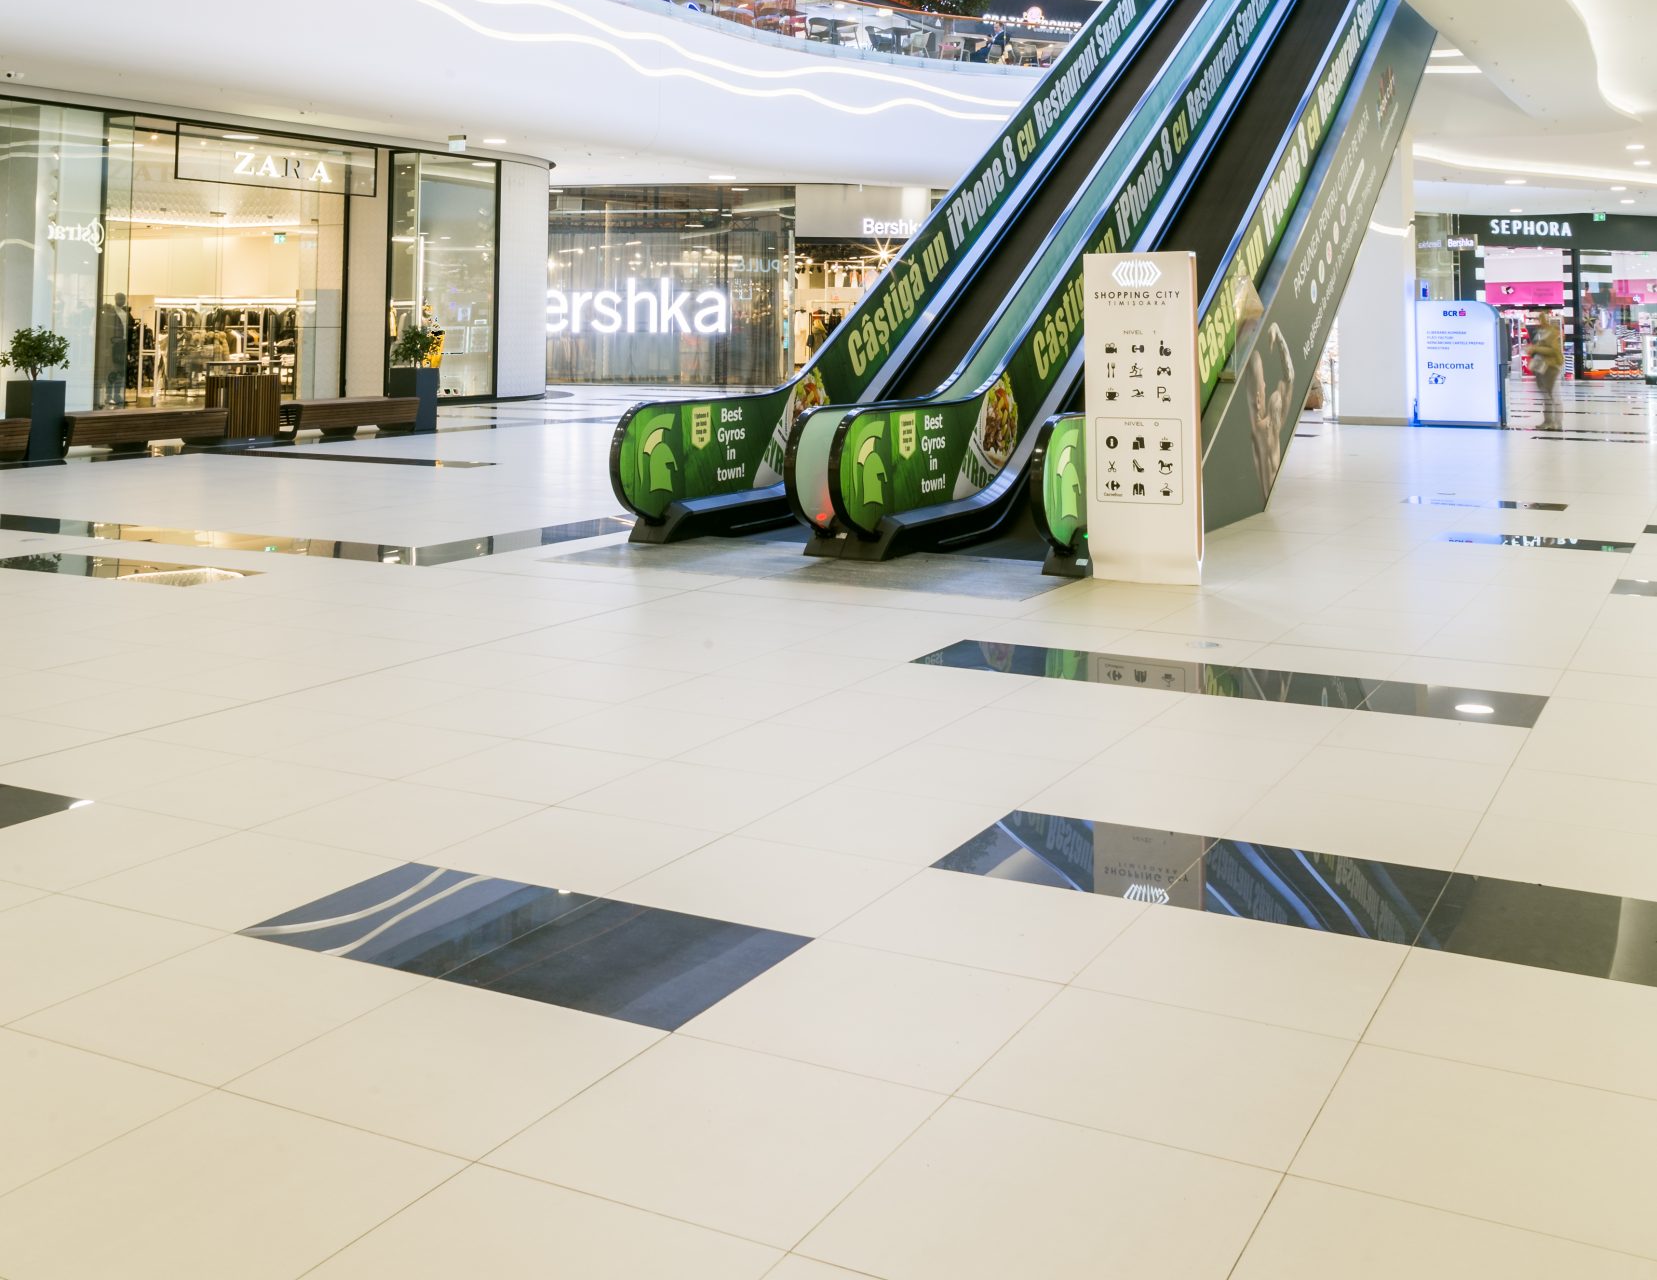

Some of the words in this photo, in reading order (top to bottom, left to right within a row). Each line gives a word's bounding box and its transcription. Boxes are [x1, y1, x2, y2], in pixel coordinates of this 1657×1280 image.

[1246, 225, 1265, 281] un
[1261, 145, 1300, 248] iPhone
[1298, 121, 1309, 168] 8
[1307, 104, 1321, 150] cu
[1317, 16, 1361, 127] Restaurant
[234, 151, 333, 183] ZARA
[848, 254, 925, 377] Câștigă
[922, 231, 950, 283] un
[946, 157, 1005, 251] iPhone
[1003, 135, 1017, 179] 8
[1016, 118, 1037, 162] cu
[1033, 40, 1099, 140] Restaurant
[1033, 272, 1084, 380] Câștig
[1114, 149, 1164, 248] iPhone
[1160, 127, 1173, 171] 8
[1172, 109, 1189, 155] cu
[1186, 23, 1240, 131] Restaurant
[863, 218, 921, 235] Bershk
[1490, 219, 1573, 237] SEPHORA
[1447, 237, 1475, 249] Bershka
[1094, 291, 1150, 300] SHOPPING
[1156, 290, 1181, 299] CITY
[546, 276, 728, 334] ershka
[1427, 361, 1475, 370] Bancomat
[721, 406, 743, 423] Best
[924, 413, 943, 431] Best
[717, 427, 746, 446] Gyros
[921, 435, 946, 455] Gyros
[726, 445, 736, 461] in
[929, 455, 938, 471] in
[717, 463, 745, 482] town!
[921, 473, 946, 494] town!
